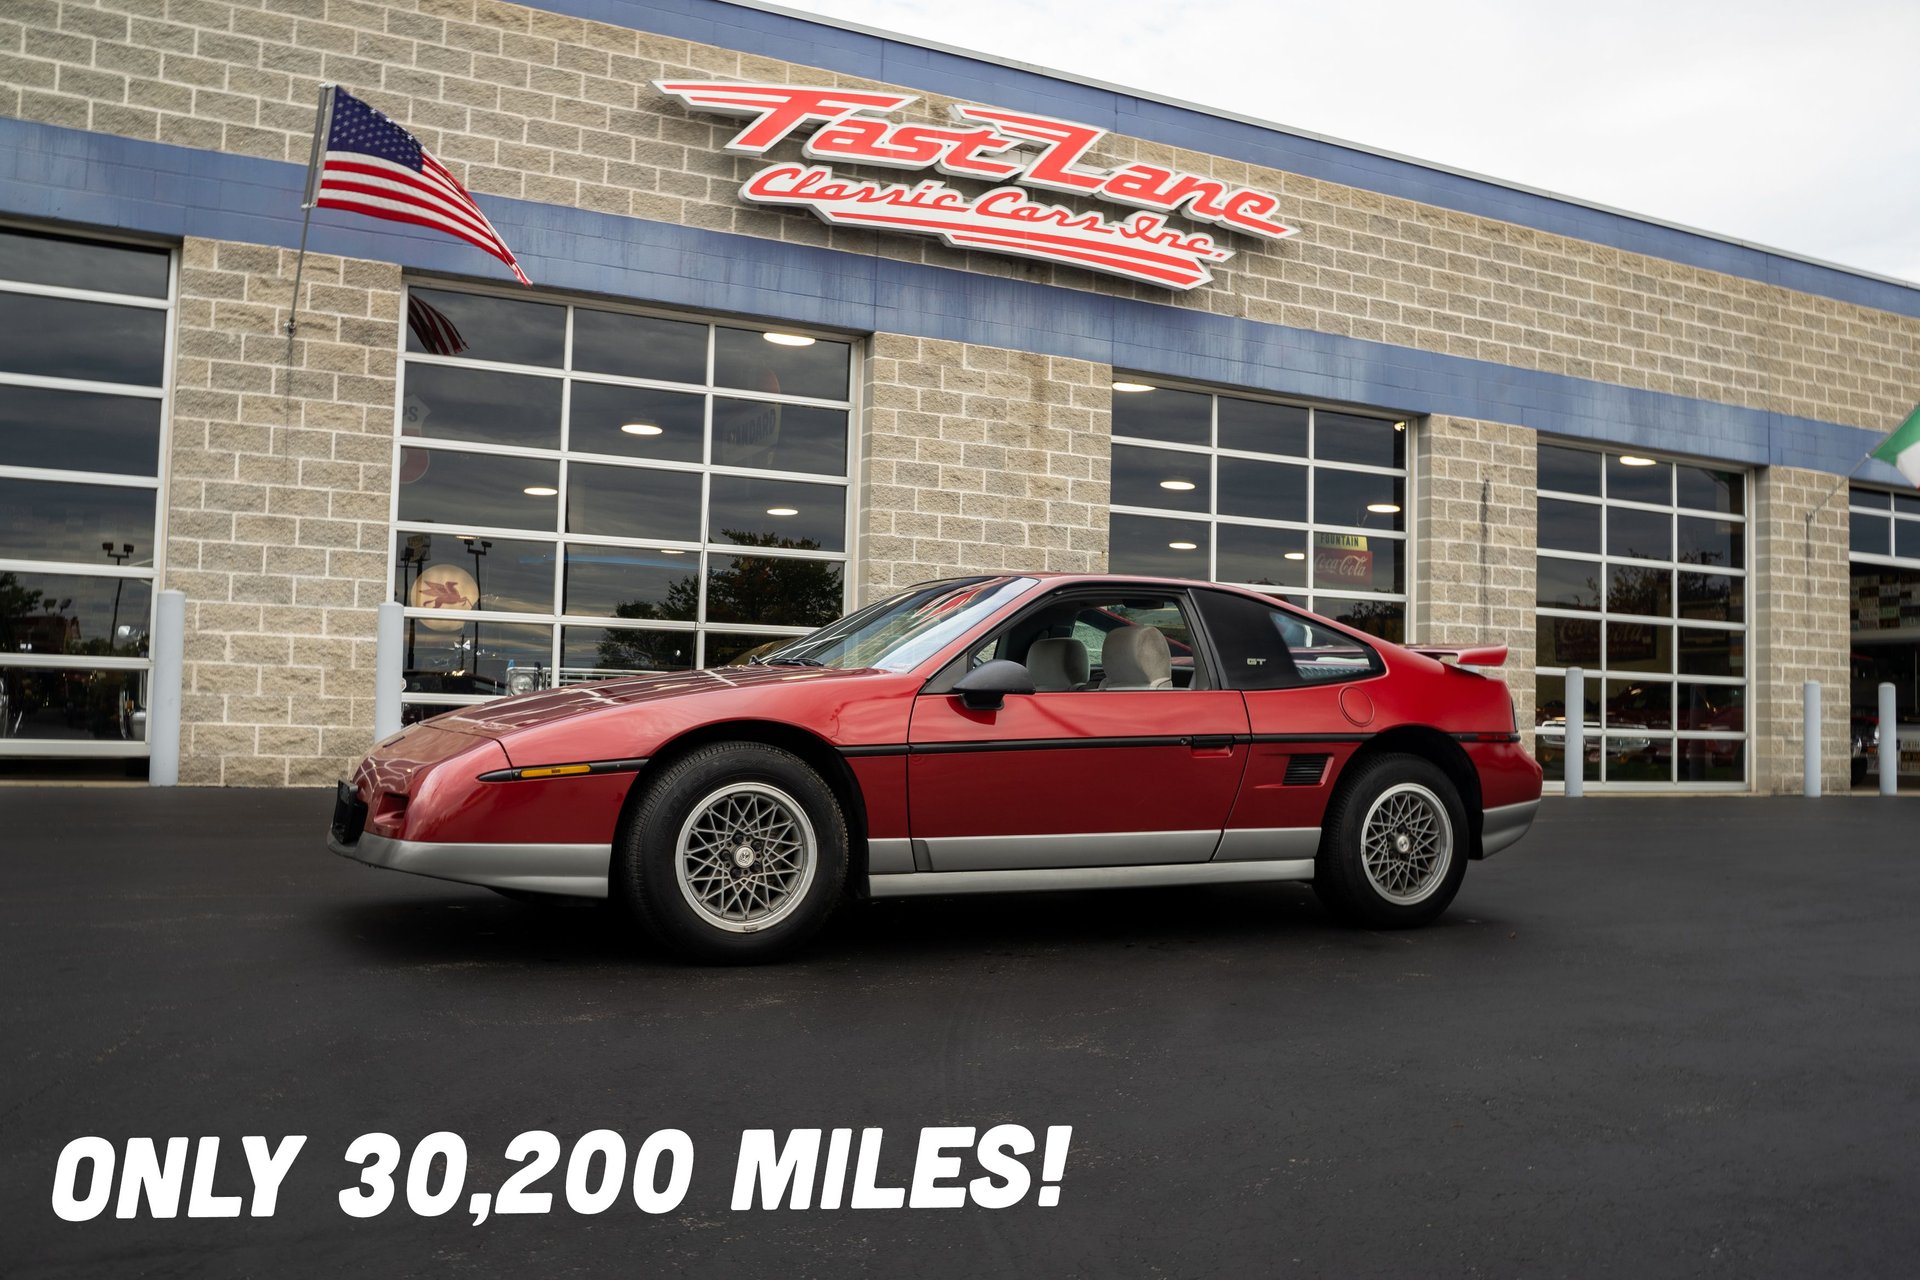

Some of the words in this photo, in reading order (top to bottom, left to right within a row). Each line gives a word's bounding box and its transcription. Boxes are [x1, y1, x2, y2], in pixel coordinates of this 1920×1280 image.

[663, 83, 1015, 174] Fast
[962, 108, 1288, 235] Lane
[748, 167, 970, 213] Classic
[975, 191, 1114, 235] Cars
[1119, 215, 1224, 258] Inc.
[1320, 534, 1359, 547] FOUNTAIN
[1246, 657, 1266, 666] GT
